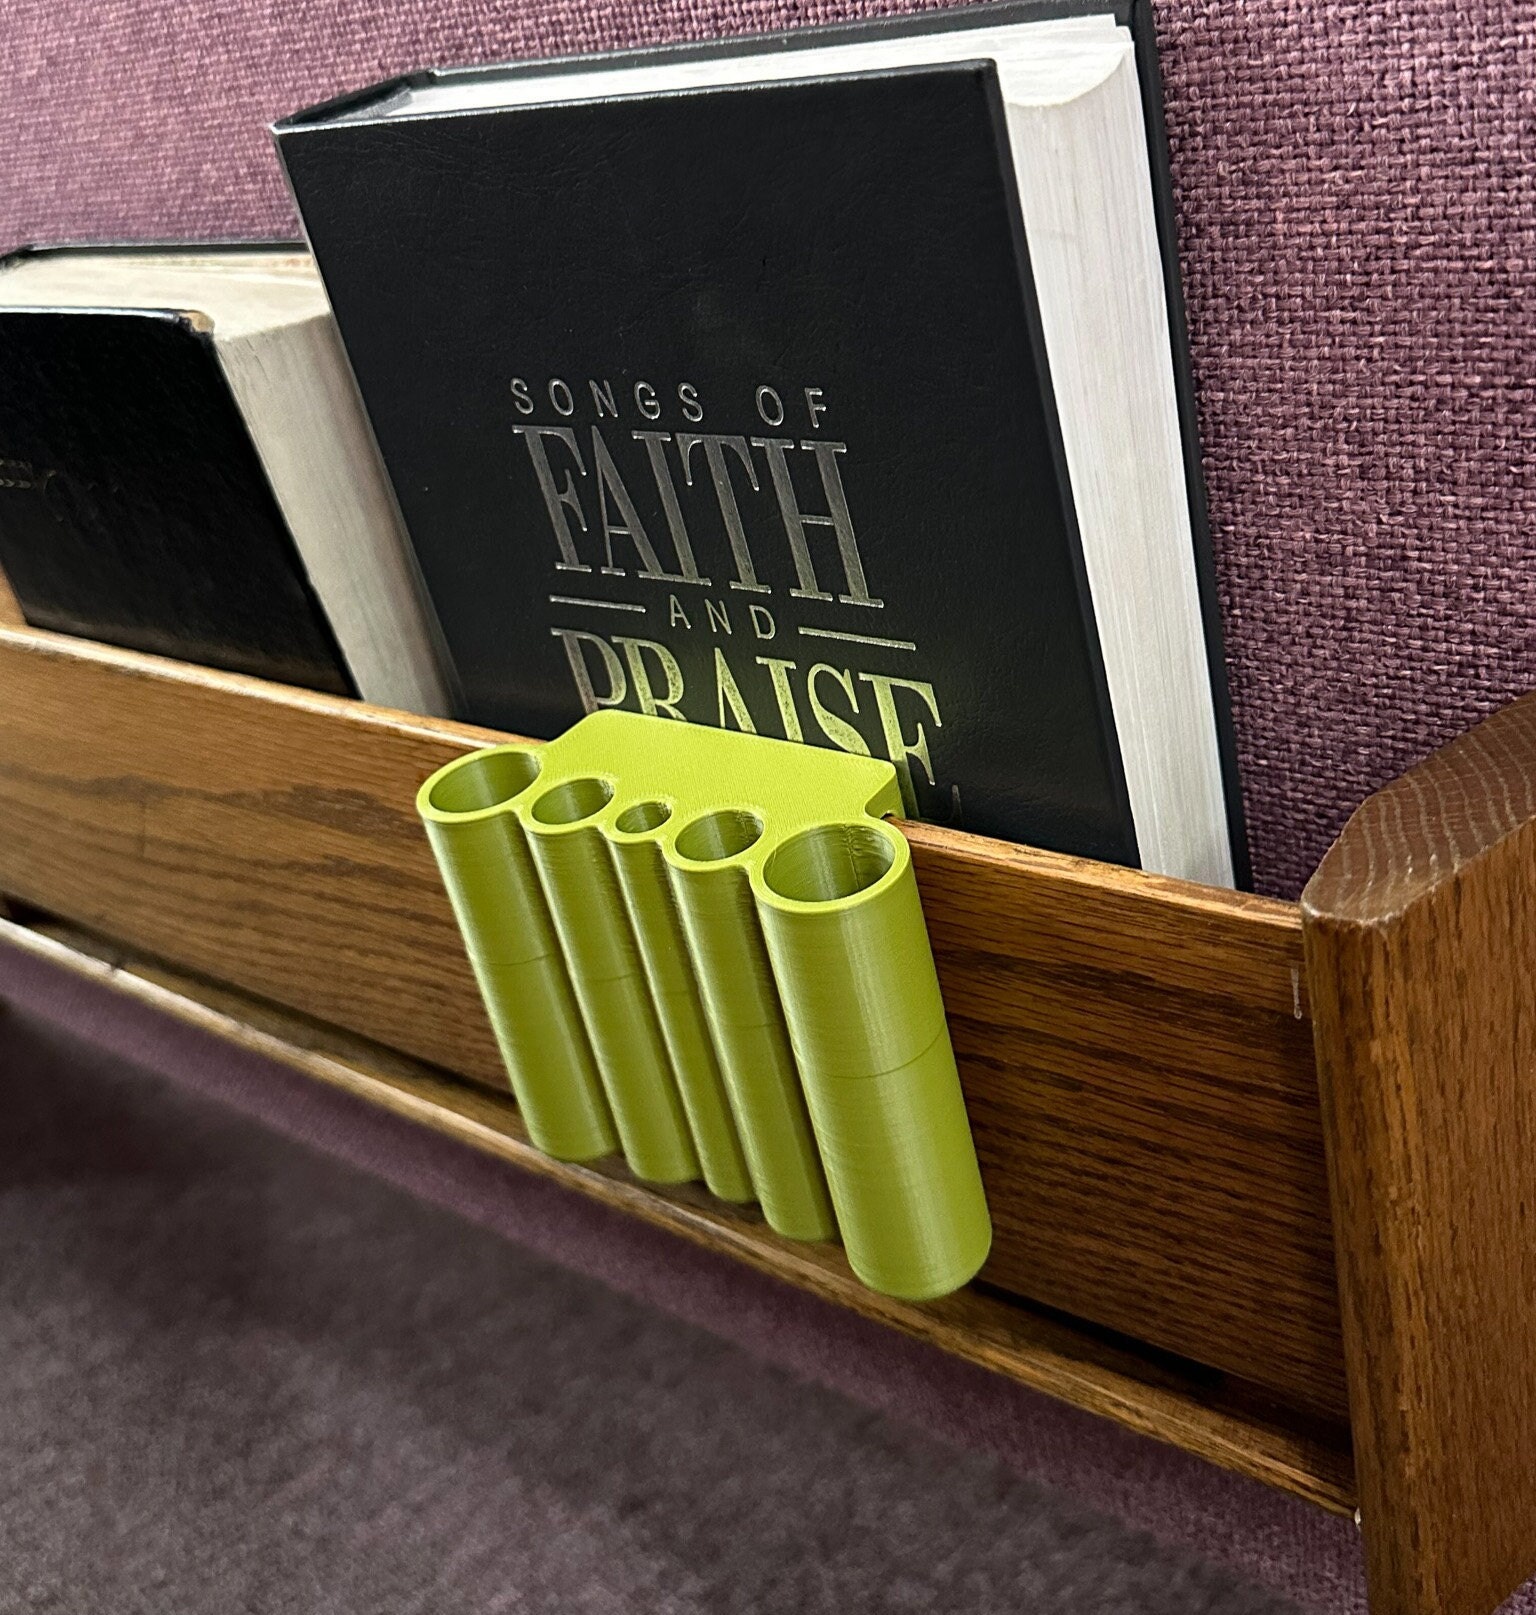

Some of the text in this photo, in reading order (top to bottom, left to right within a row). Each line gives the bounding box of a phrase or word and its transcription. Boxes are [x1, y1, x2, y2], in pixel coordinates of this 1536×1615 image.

[511, 378, 826, 428] SONGS OF
[512, 424, 884, 608] FAITH
[670, 595, 776, 640] AND
